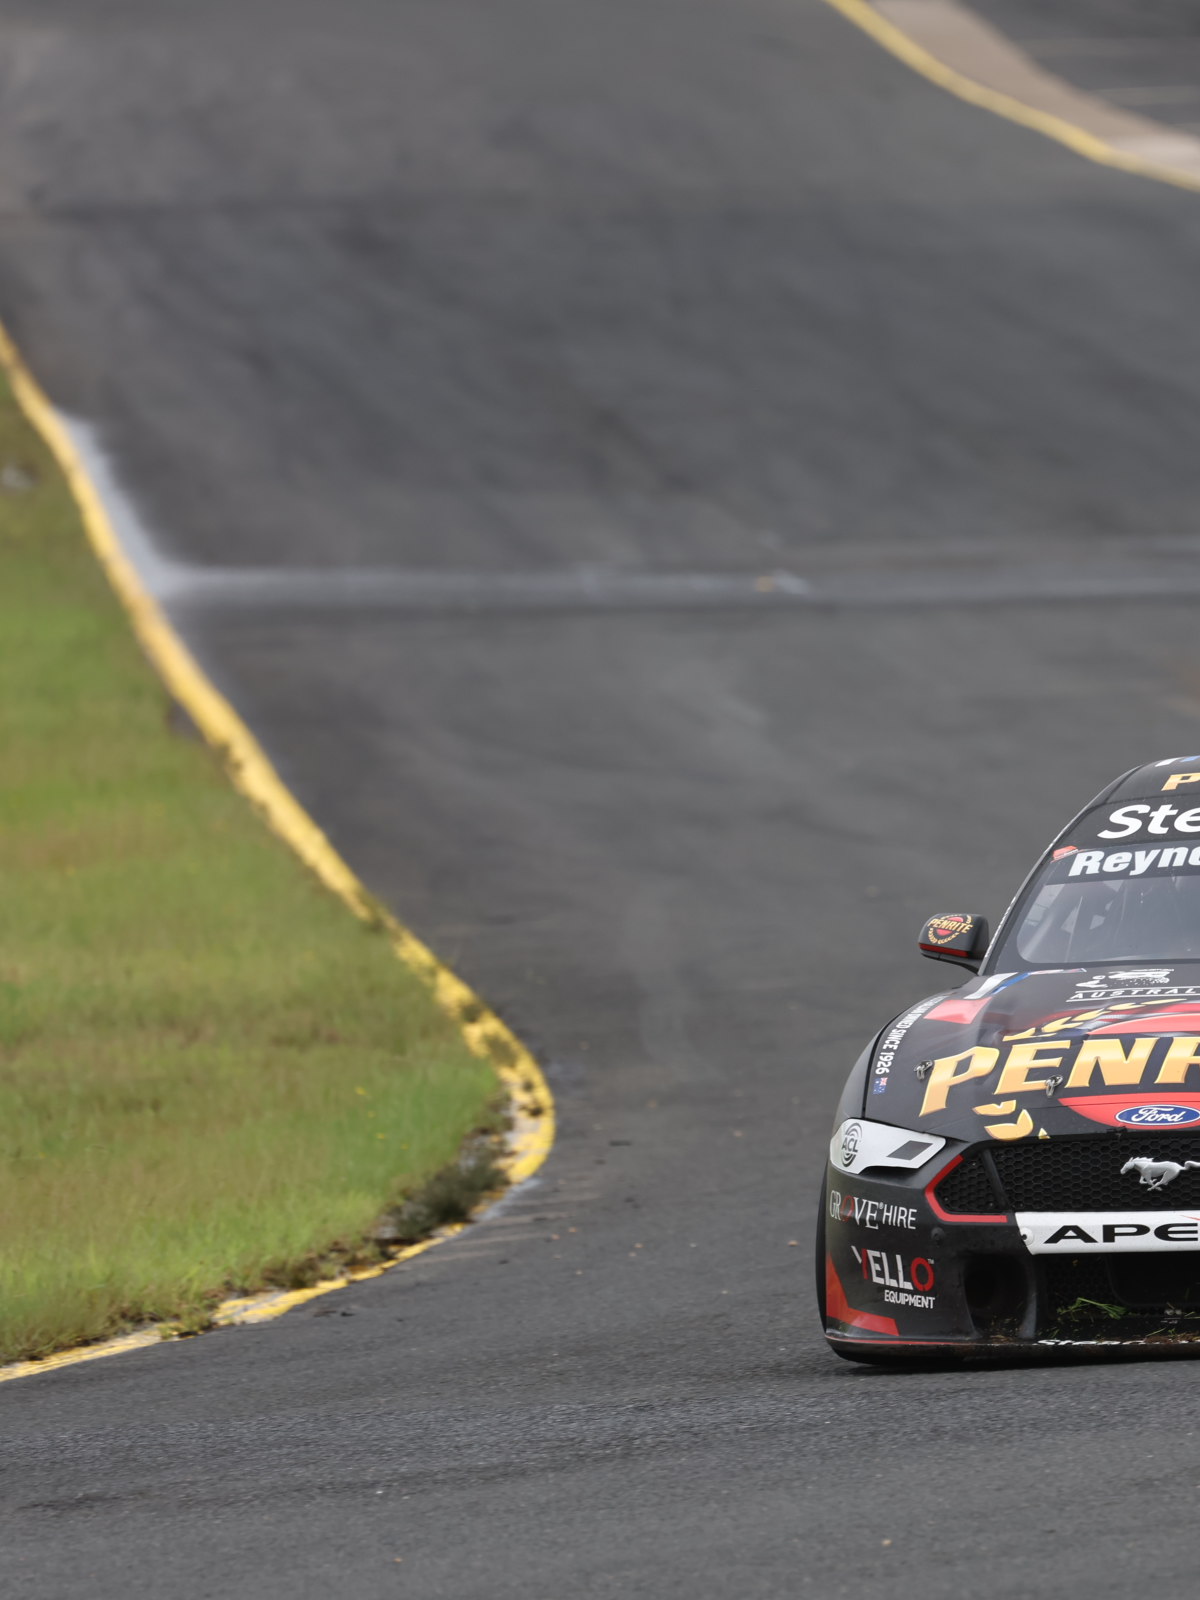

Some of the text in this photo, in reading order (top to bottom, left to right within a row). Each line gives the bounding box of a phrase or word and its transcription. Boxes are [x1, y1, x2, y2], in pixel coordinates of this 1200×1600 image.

[927, 918, 973, 933] PENRITE
[875, 1051, 895, 1075] 1926
[1131, 1107, 1187, 1122] Ford
[841, 1137, 859, 1153] ACL
[882, 1204, 918, 1230] HIRE
[851, 1245, 935, 1292] YELLO
[884, 1290, 936, 1309] EQUIPMENT
